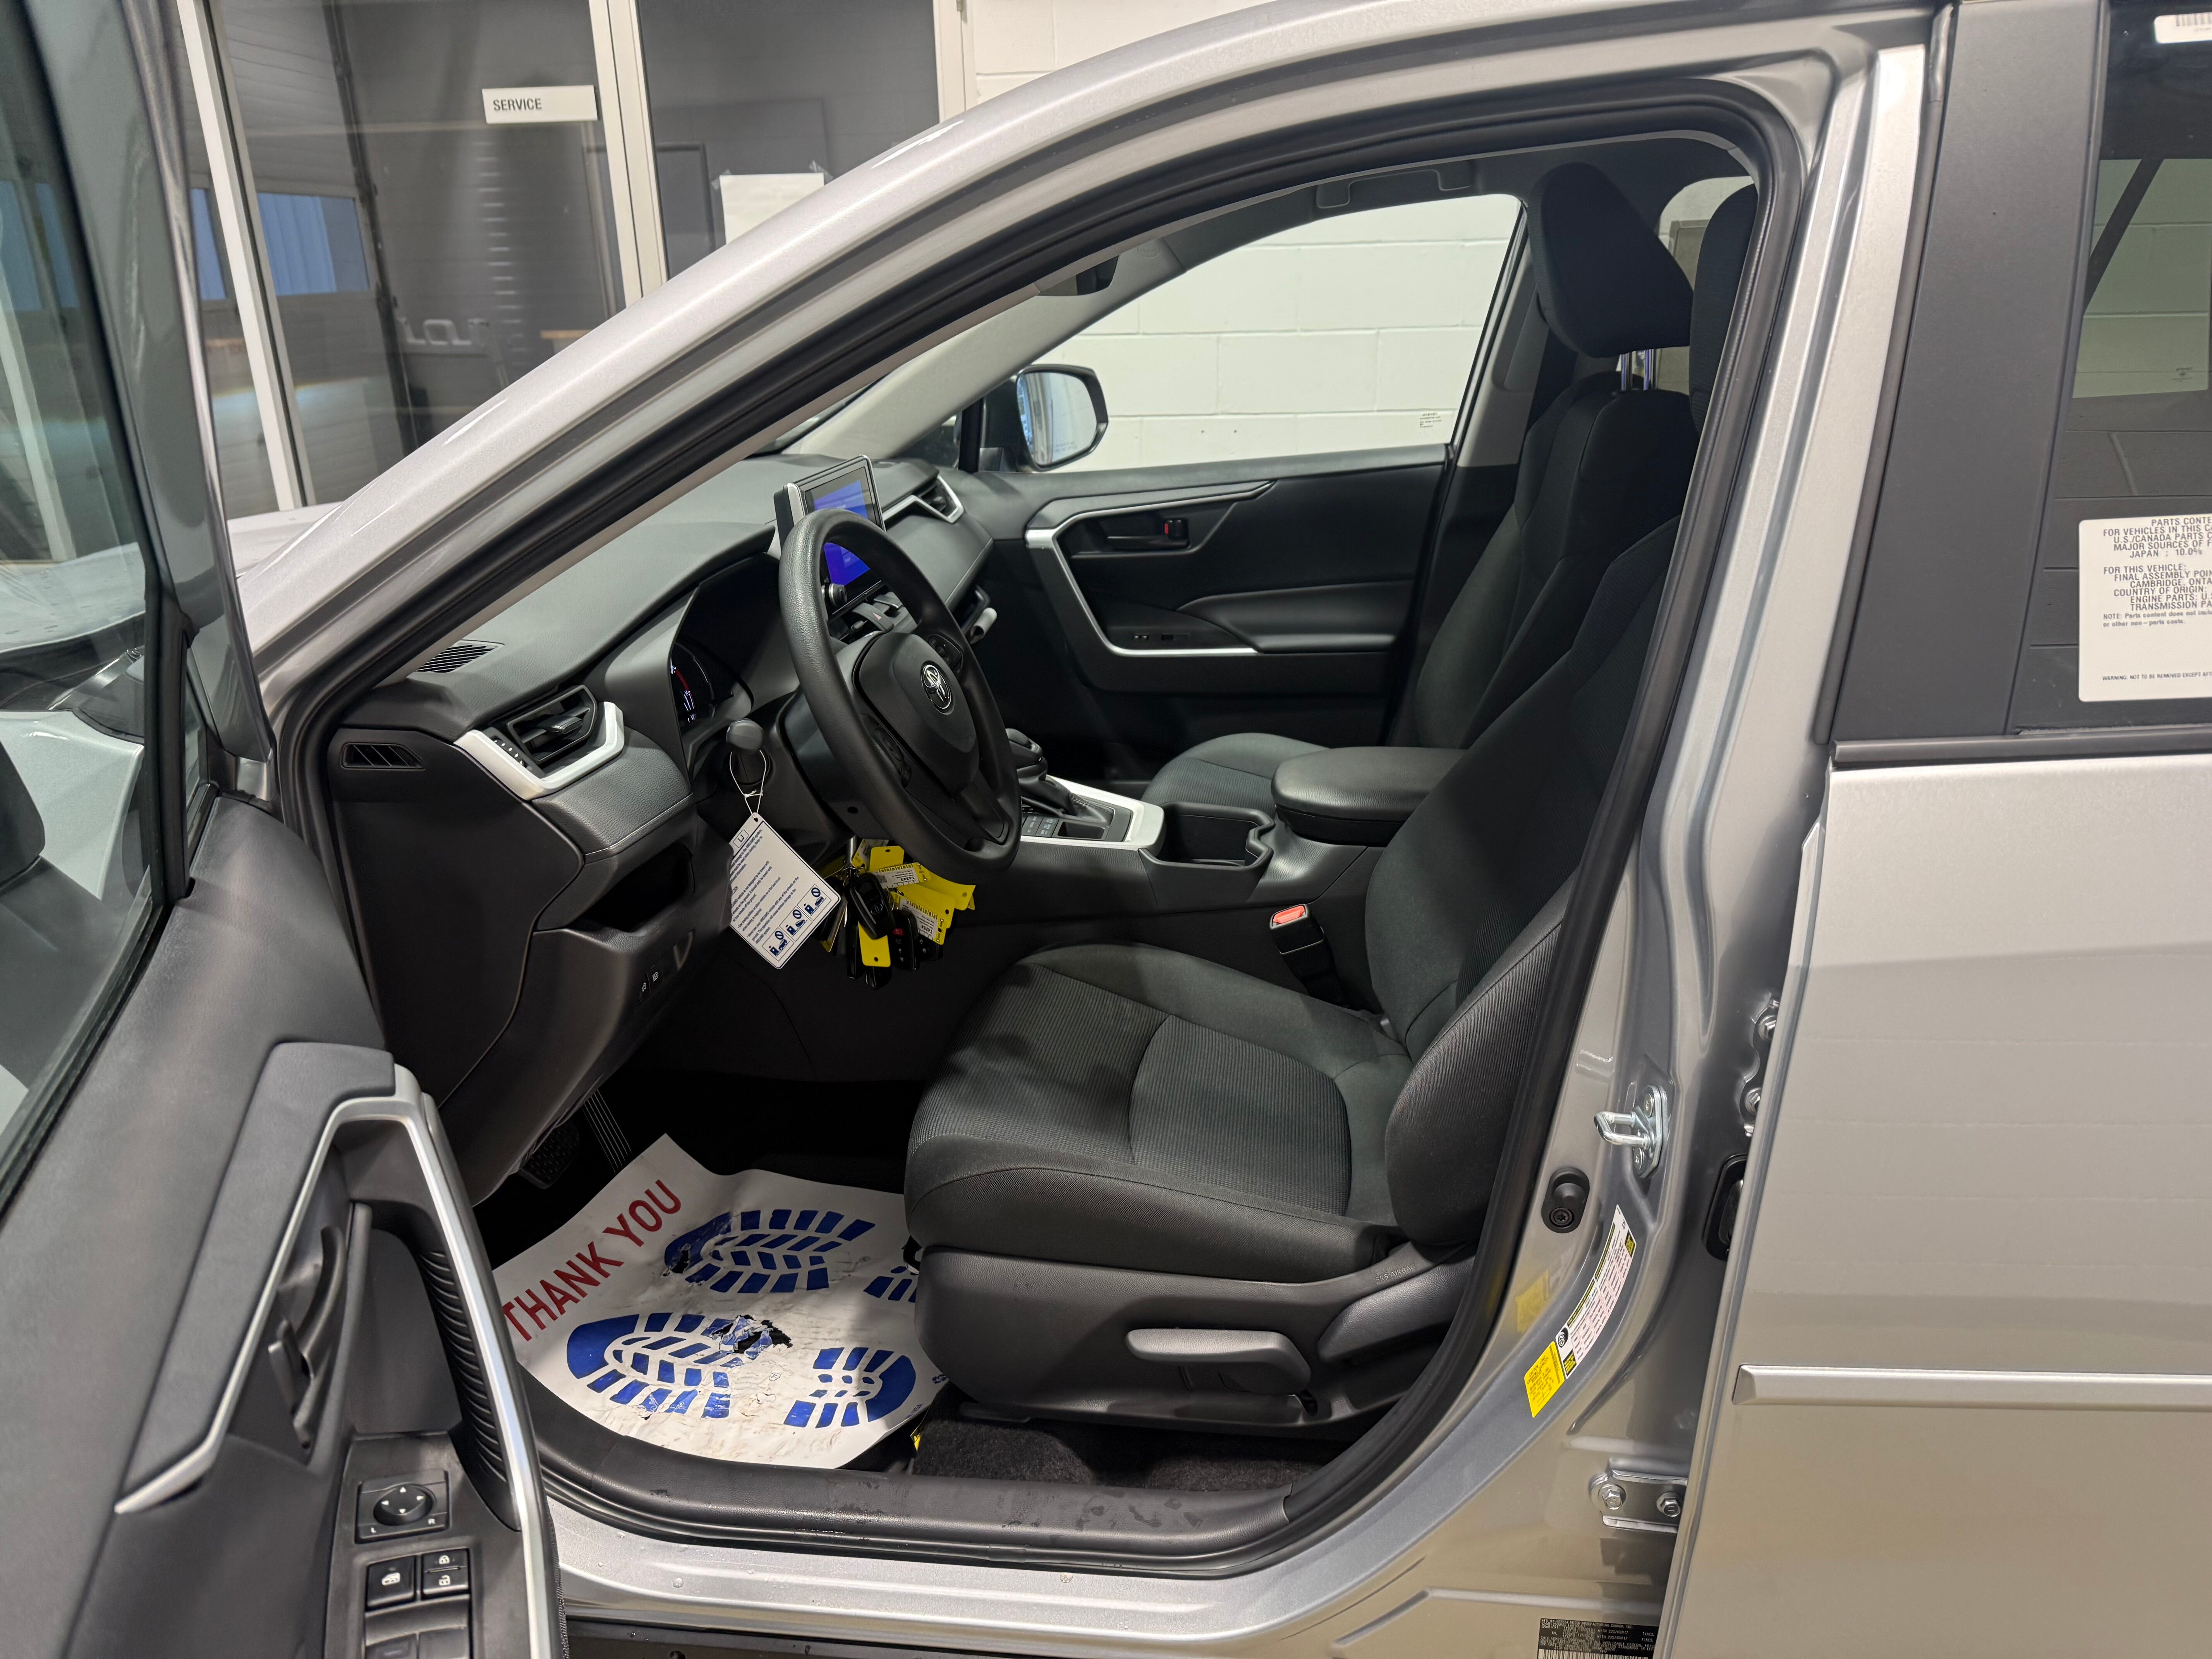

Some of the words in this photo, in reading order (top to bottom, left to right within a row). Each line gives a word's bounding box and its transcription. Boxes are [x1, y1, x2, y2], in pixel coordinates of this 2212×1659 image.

[493, 98, 542, 112] SERVICE
[2152, 518, 2180, 526] PARTS
[2123, 526, 2165, 535] VEHICLES
[2114, 534, 2171, 544] U.S./CANADA
[2175, 532, 2203, 540] PARTS
[2148, 540, 2188, 549] SOURCES
[2130, 550, 2159, 558] JAPAN
[2147, 563, 2186, 572] VEHICLE:
[2142, 571, 2190, 580] ASSEMBLY
[2114, 588, 2155, 596] COUNTRY
[2173, 586, 2207, 594] ORIGIN:
[2130, 595, 2162, 603] ENGINE
[2166, 593, 2198, 601] PARTS:
[2130, 601, 2197, 611] TRANSMISSION
[502, 1241, 624, 1341] THANK
[603, 1179, 682, 1247] YOU
[1376, 1273, 1389, 1282] SRS
[1391, 1264, 1415, 1277] AIRBAG
